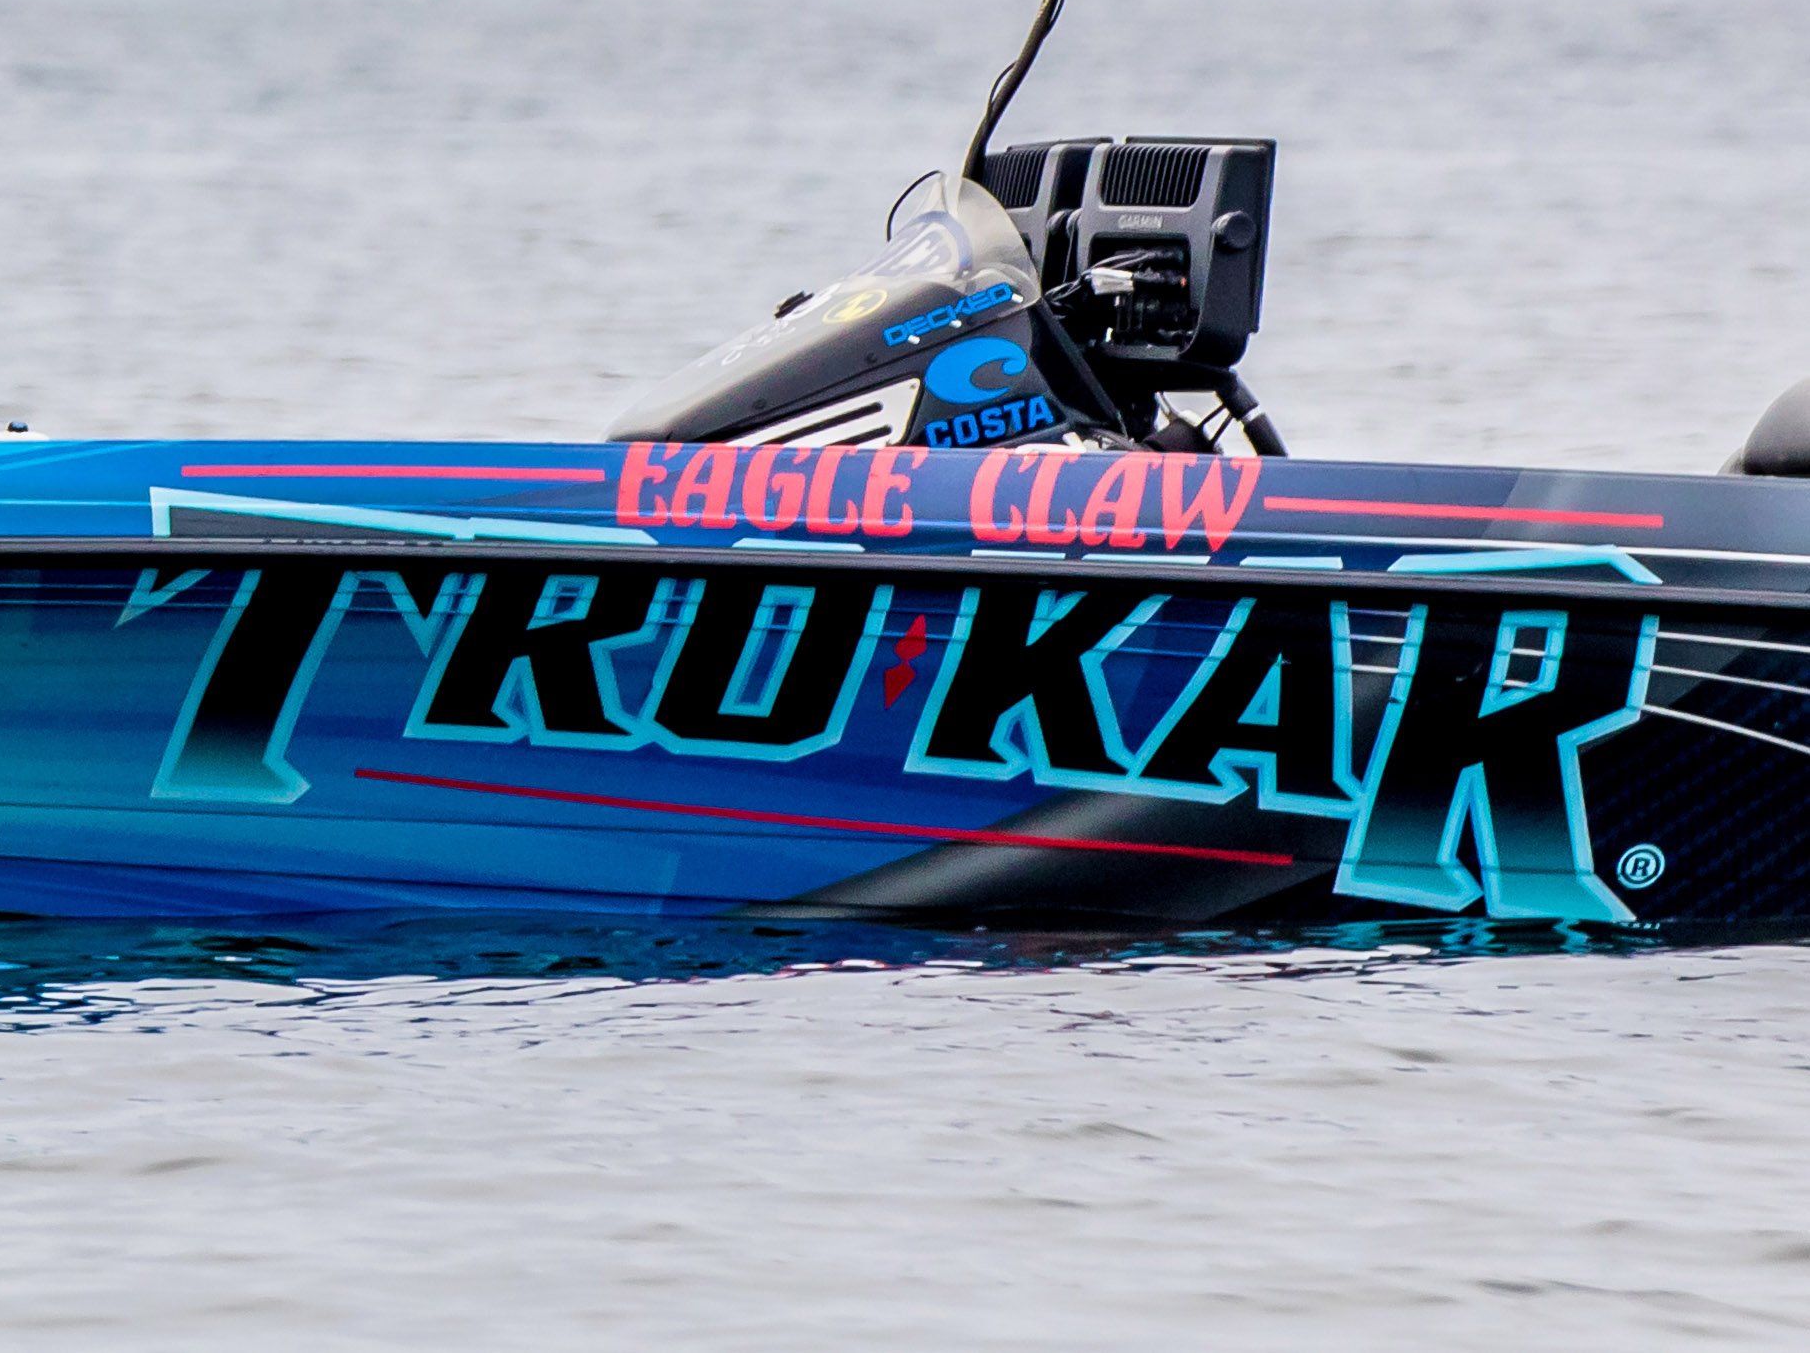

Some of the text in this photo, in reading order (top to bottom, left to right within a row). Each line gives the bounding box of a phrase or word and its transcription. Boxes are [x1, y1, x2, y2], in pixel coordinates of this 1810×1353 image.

[1118, 215, 1164, 229] GARMIN
[883, 282, 1016, 347] DECKED
[924, 396, 1055, 449] COSTA
[615, 442, 1262, 553] EAGLE CLAW
[114, 487, 1664, 922] TROKAR
